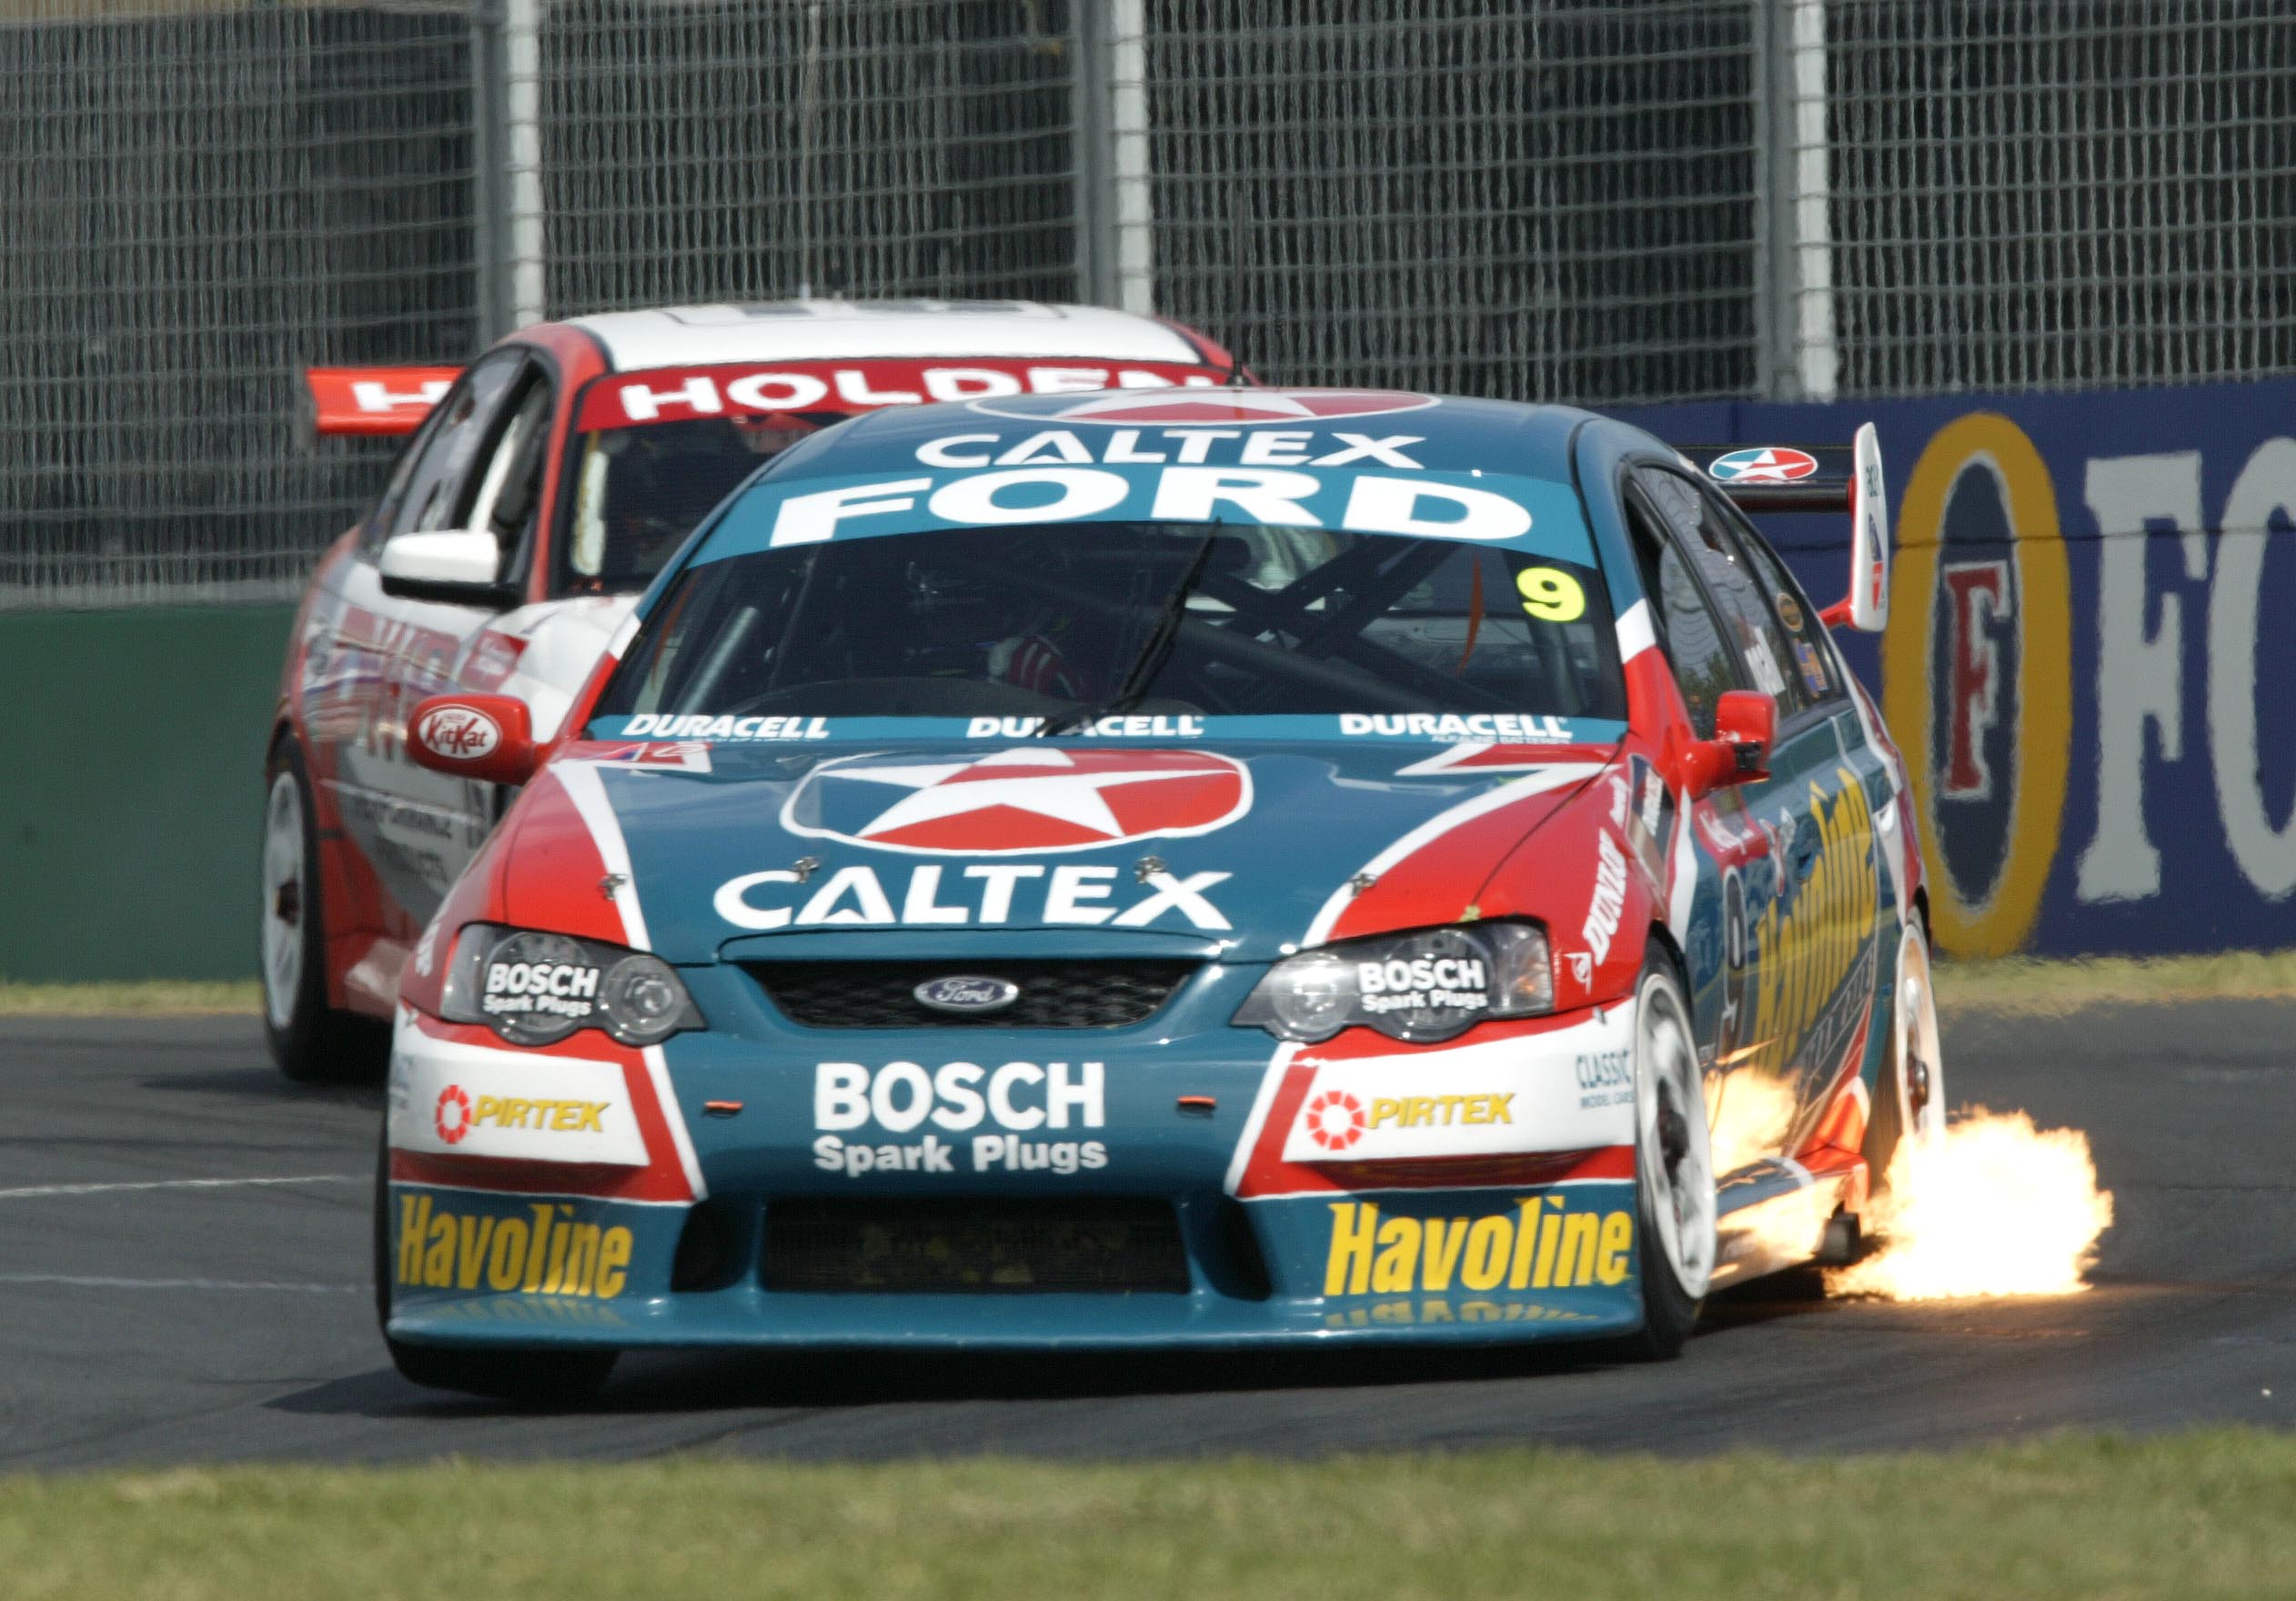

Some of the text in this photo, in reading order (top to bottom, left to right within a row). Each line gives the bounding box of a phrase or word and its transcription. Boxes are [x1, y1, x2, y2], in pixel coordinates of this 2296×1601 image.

[915, 429, 1426, 470] CALTEX
[770, 466, 1533, 547] FORD
[1516, 566, 1586, 623] 9
[1944, 559, 2009, 802] F
[620, 713, 831, 739] DURACELL
[966, 715, 1204, 739] DUCELL
[1339, 713, 1574, 740] DURACELL
[713, 864, 1234, 931] CALTEX
[485, 962, 600, 997] BOSCH
[933, 979, 996, 1003] Ford
[1357, 959, 1485, 993] BOSCH
[482, 992, 592, 1018] Spark Plugs
[1364, 988, 1487, 1012] Spark Plugs
[471, 1095, 611, 1133] PIRTEK
[813, 1061, 1106, 1133] BOSCH
[1367, 1093, 1516, 1130] PIRTEK
[812, 1133, 1109, 1177] Spark Plugs
[398, 1193, 634, 1299] Havoline
[1323, 1194, 1634, 1296] Havoline
